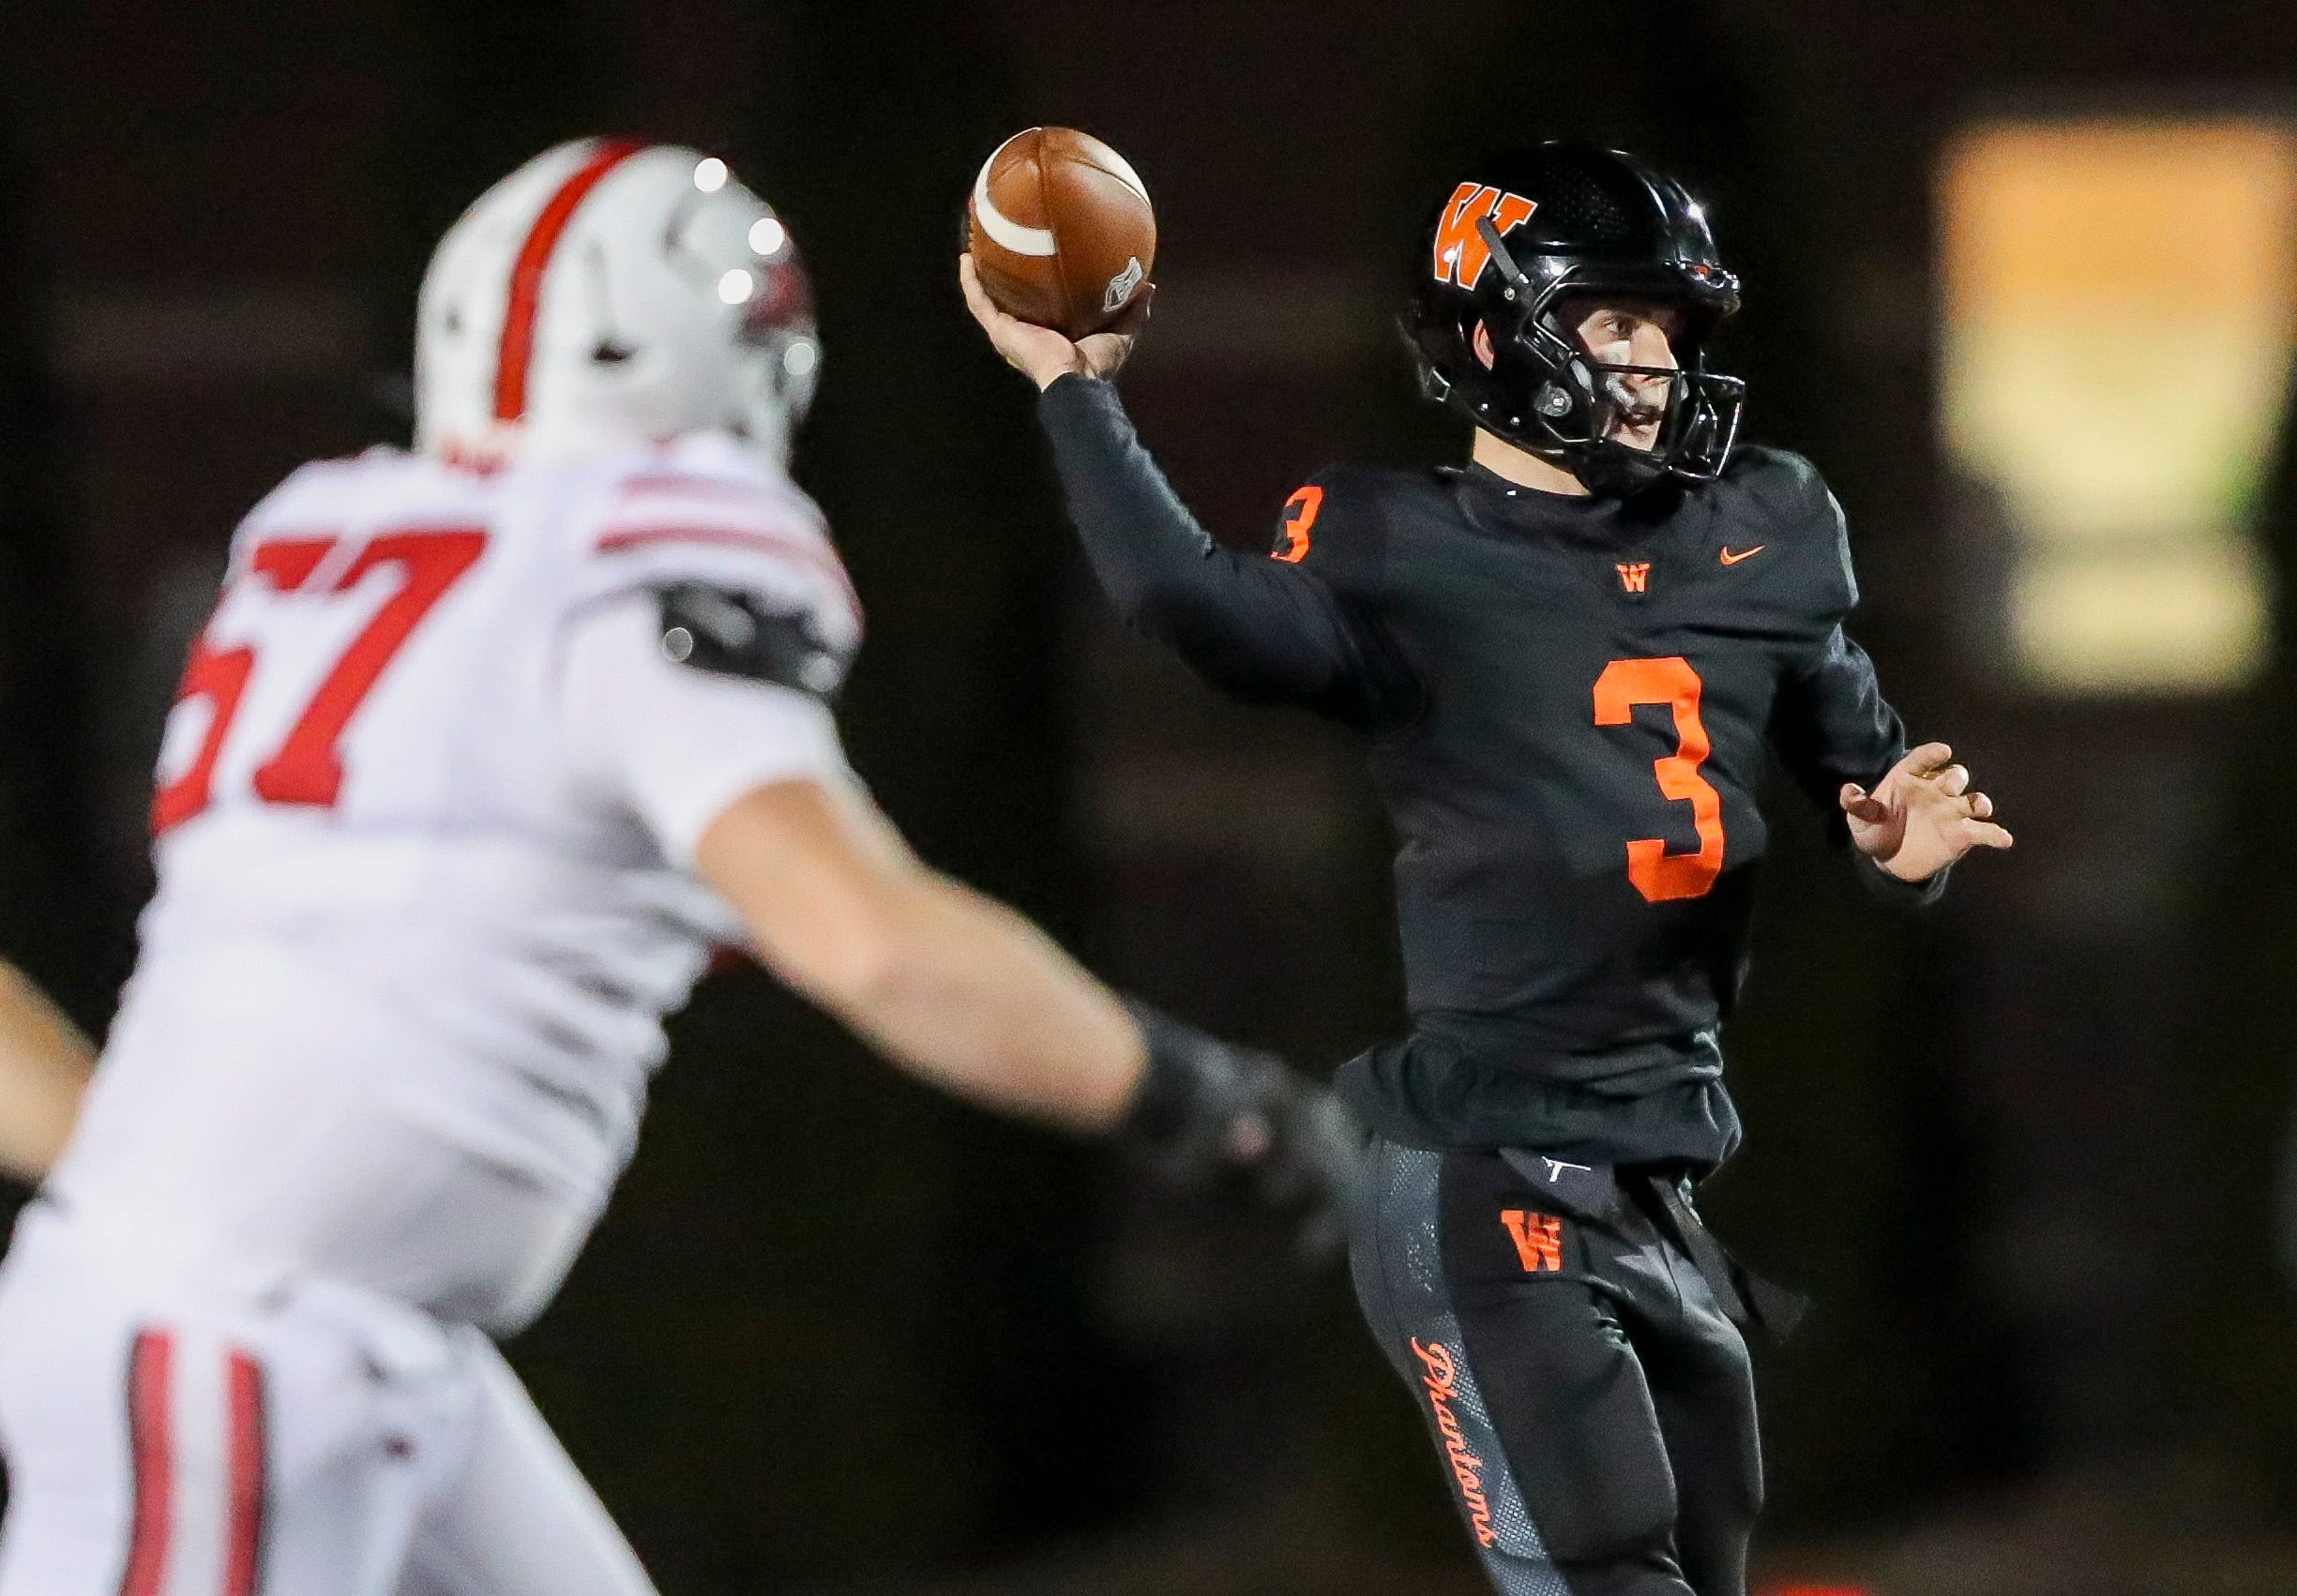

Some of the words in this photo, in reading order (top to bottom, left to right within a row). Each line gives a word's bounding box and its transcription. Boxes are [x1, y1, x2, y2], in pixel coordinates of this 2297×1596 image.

[1434, 181, 1538, 291] W
[1270, 485, 1323, 564] 3
[1616, 563, 1651, 593] W
[150, 528, 490, 836] 57
[1593, 656, 1725, 904] 3
[1501, 1210, 1562, 1272] W
[1410, 1335, 1498, 1549] Phantoms
